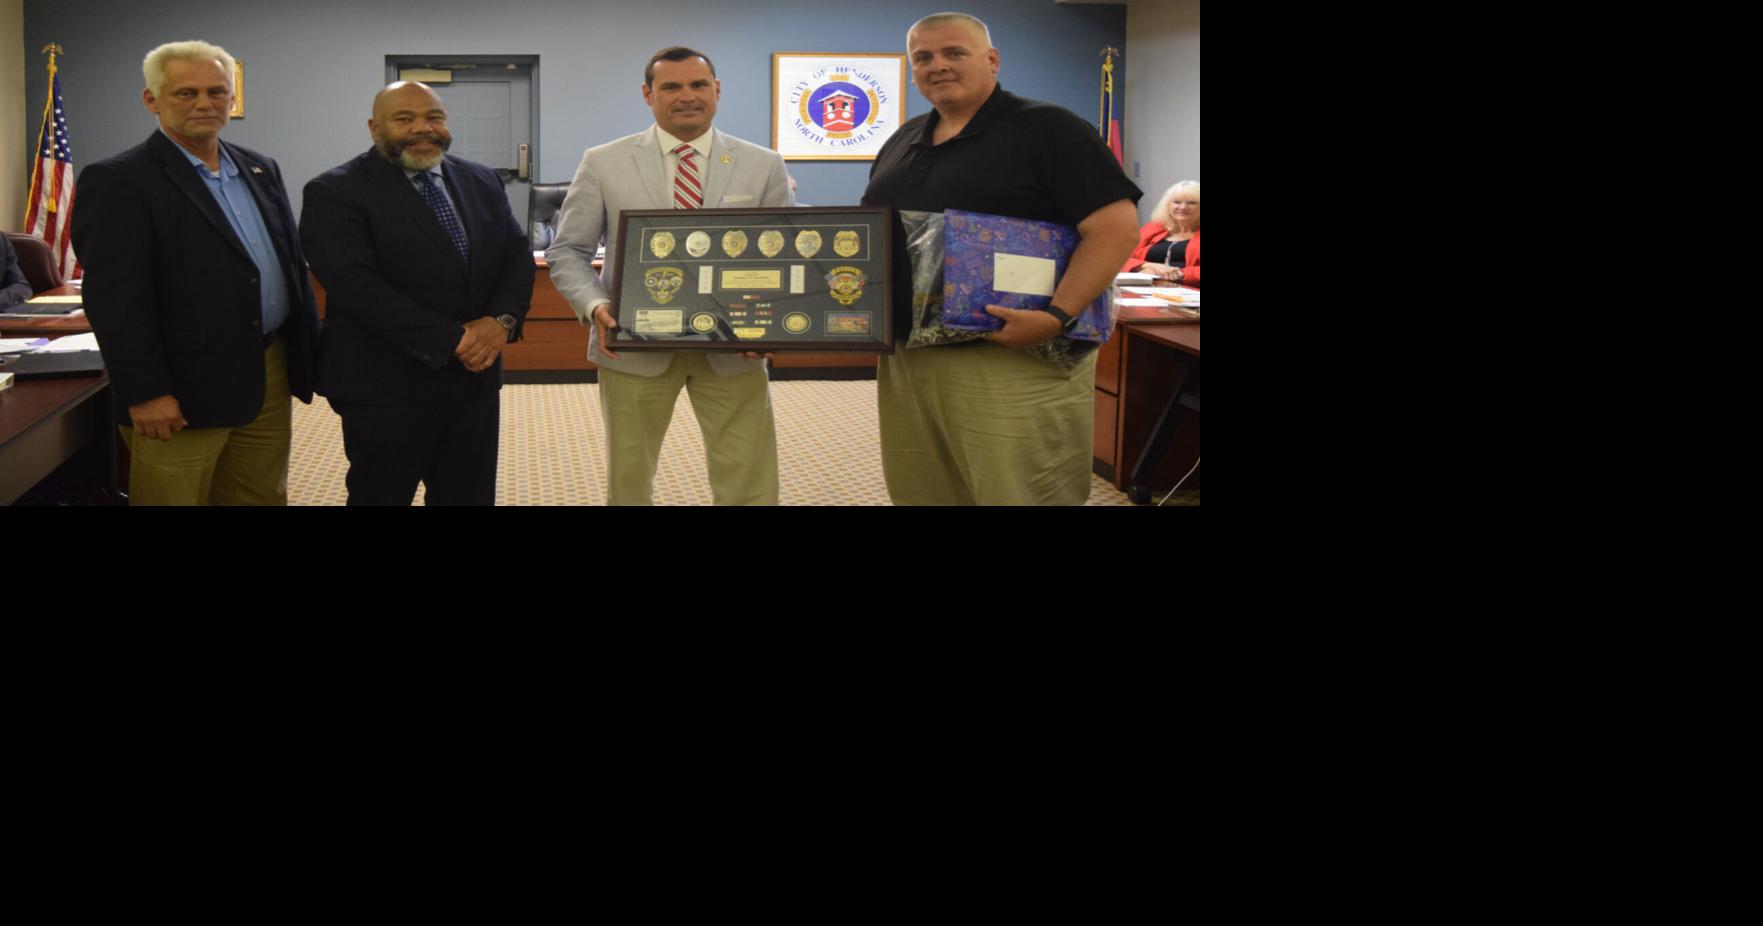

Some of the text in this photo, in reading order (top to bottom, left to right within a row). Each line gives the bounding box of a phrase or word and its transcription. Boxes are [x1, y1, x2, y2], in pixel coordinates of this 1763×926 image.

[791, 66, 888, 104] CITY OF HENDERSON
[794, 118, 885, 146] NORTH CAROLINA
